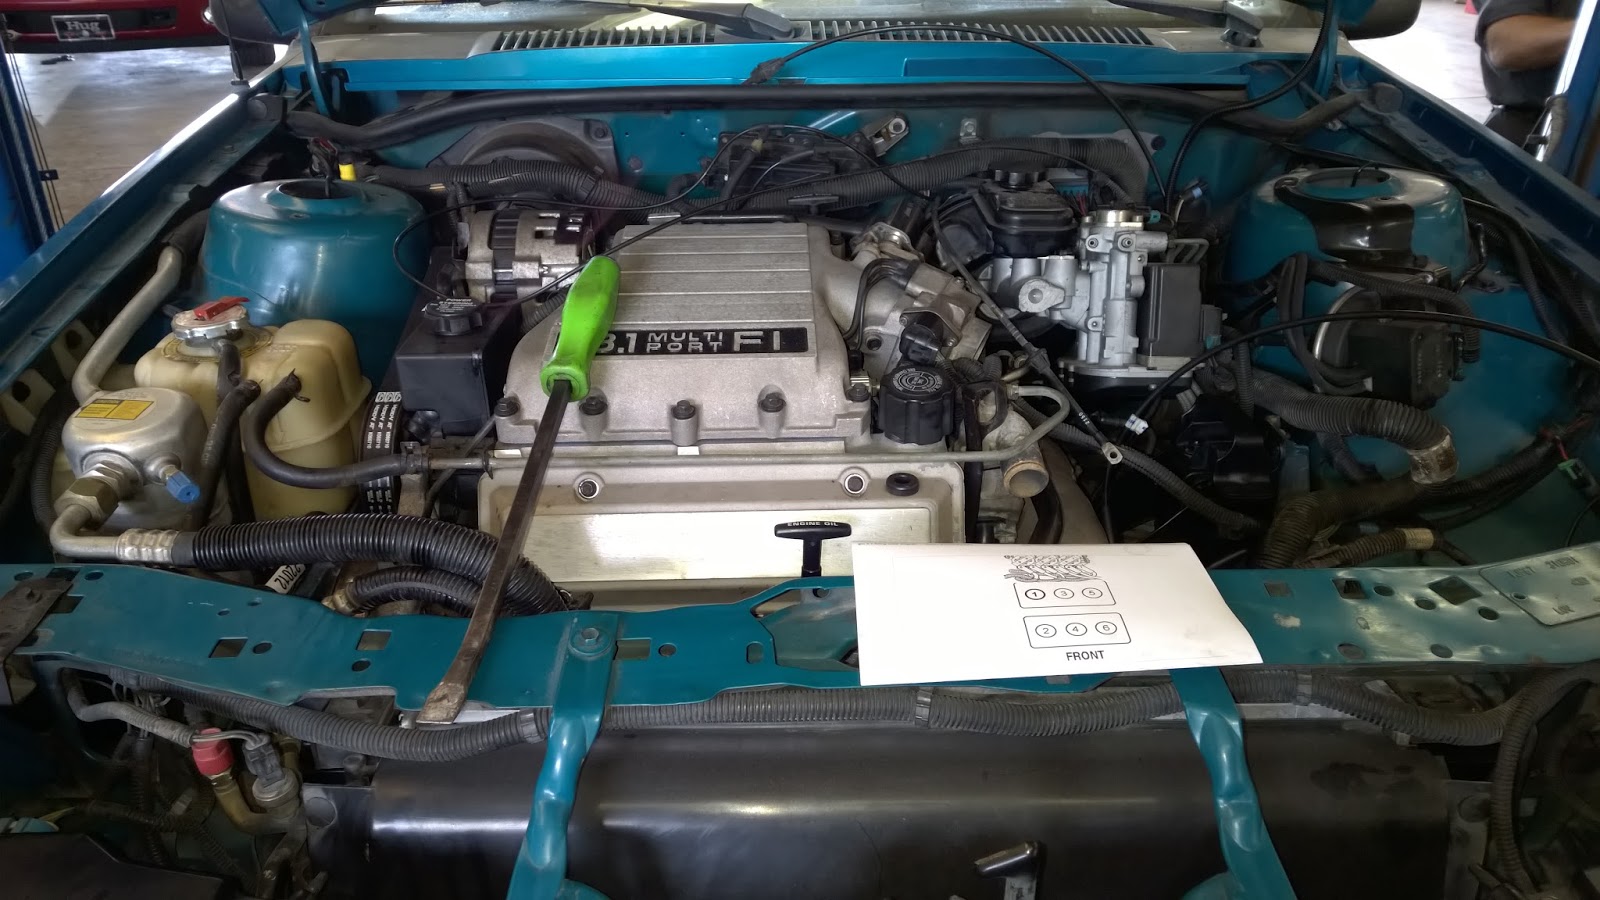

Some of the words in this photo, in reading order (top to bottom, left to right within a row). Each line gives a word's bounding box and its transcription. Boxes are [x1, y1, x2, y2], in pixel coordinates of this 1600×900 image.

[65, 21, 100, 33] Hug
[599, 332, 637, 353] 3.1
[647, 331, 723, 342] MULTI
[733, 330, 781, 351] FI
[646, 341, 723, 353] PORT
[1065, 650, 1105, 661] FRONT
